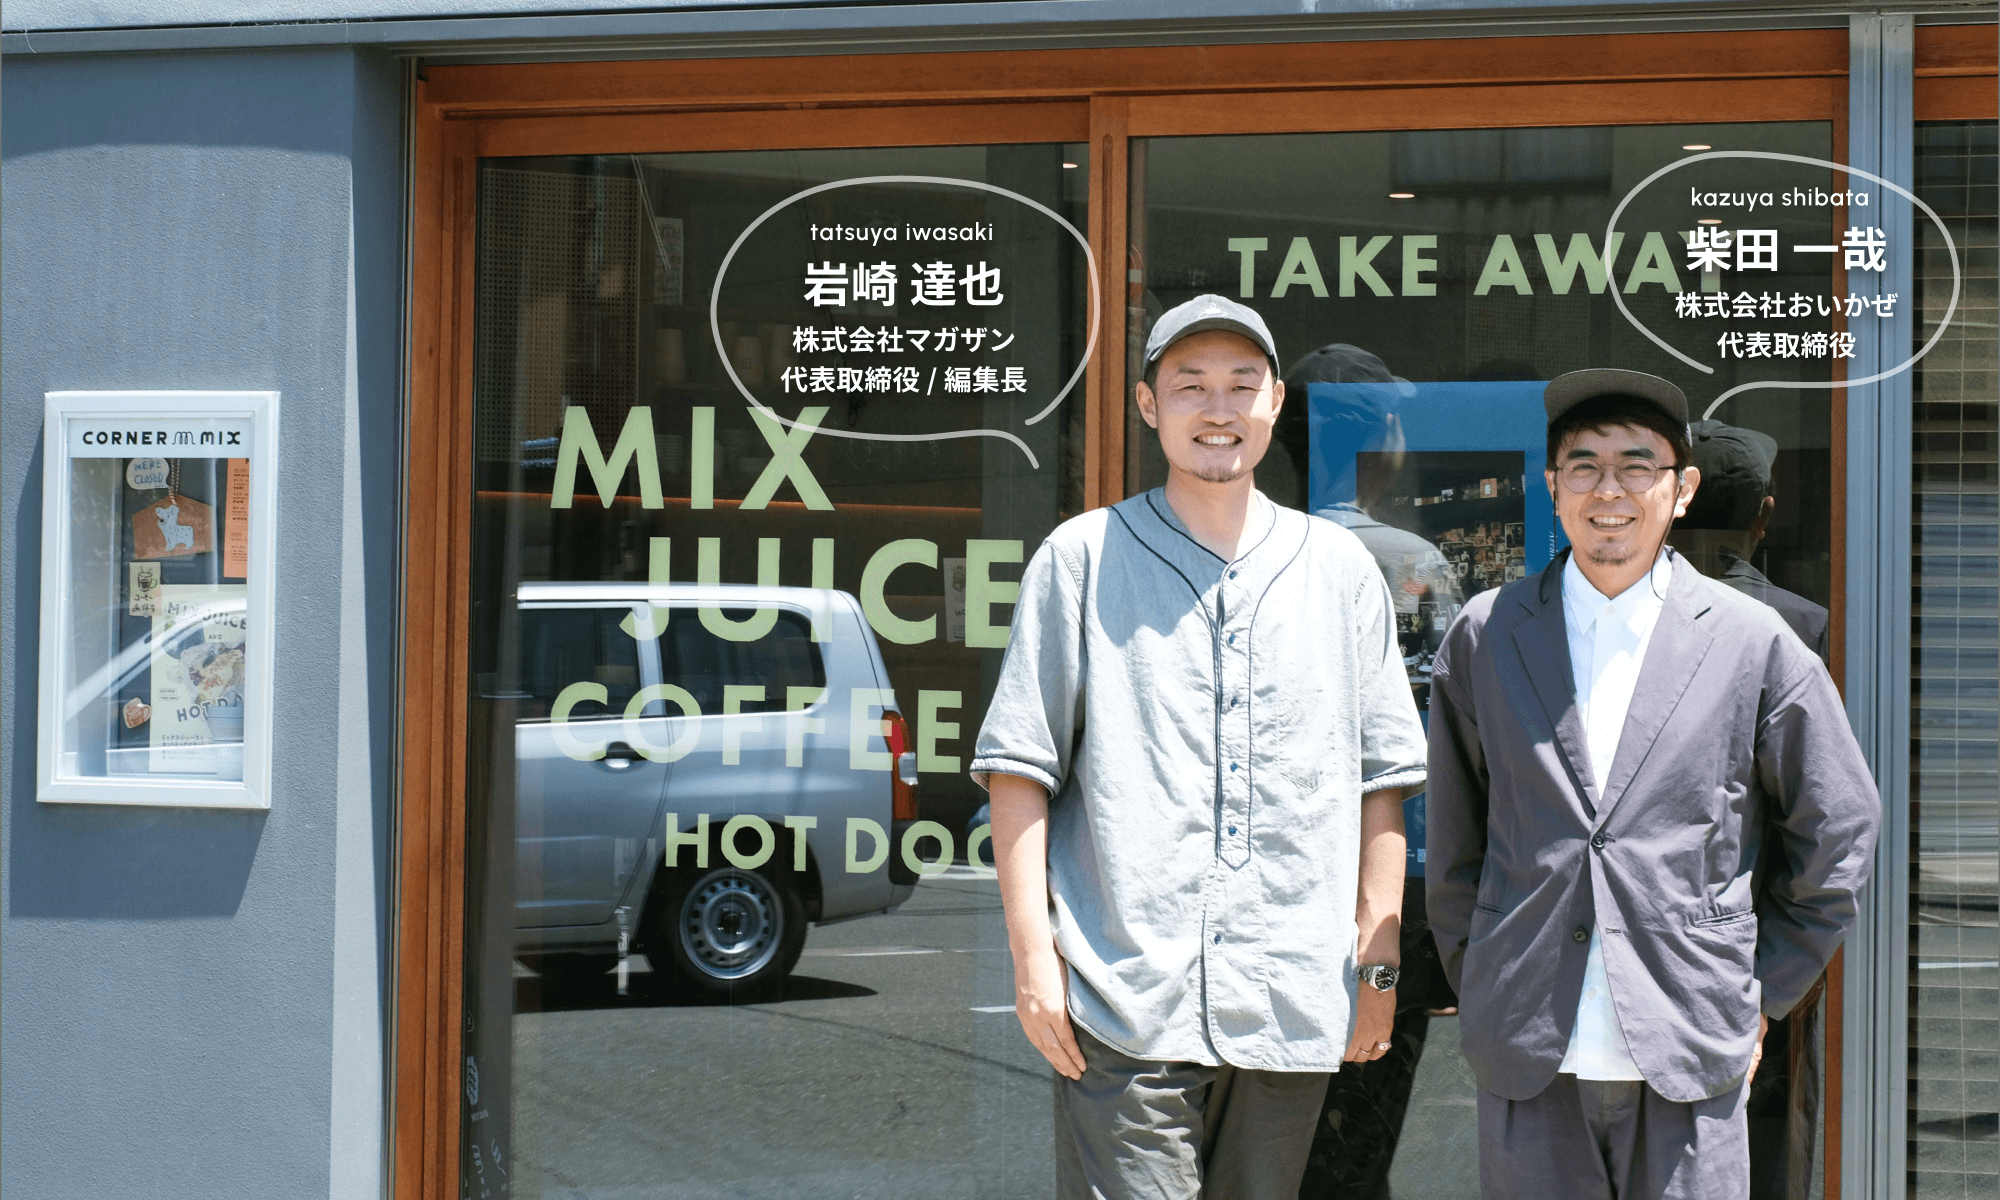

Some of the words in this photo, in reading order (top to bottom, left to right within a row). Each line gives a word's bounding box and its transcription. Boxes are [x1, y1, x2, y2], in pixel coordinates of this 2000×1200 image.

[1228, 234, 1438, 298] TAKE
[1473, 232, 1737, 297] AWAY
[82, 431, 168, 445] CORNER
[550, 405, 835, 511] MIX
[619, 536, 1025, 649] JUICE
[550, 681, 962, 774] COFFEE
[665, 812, 818, 872] HOT
